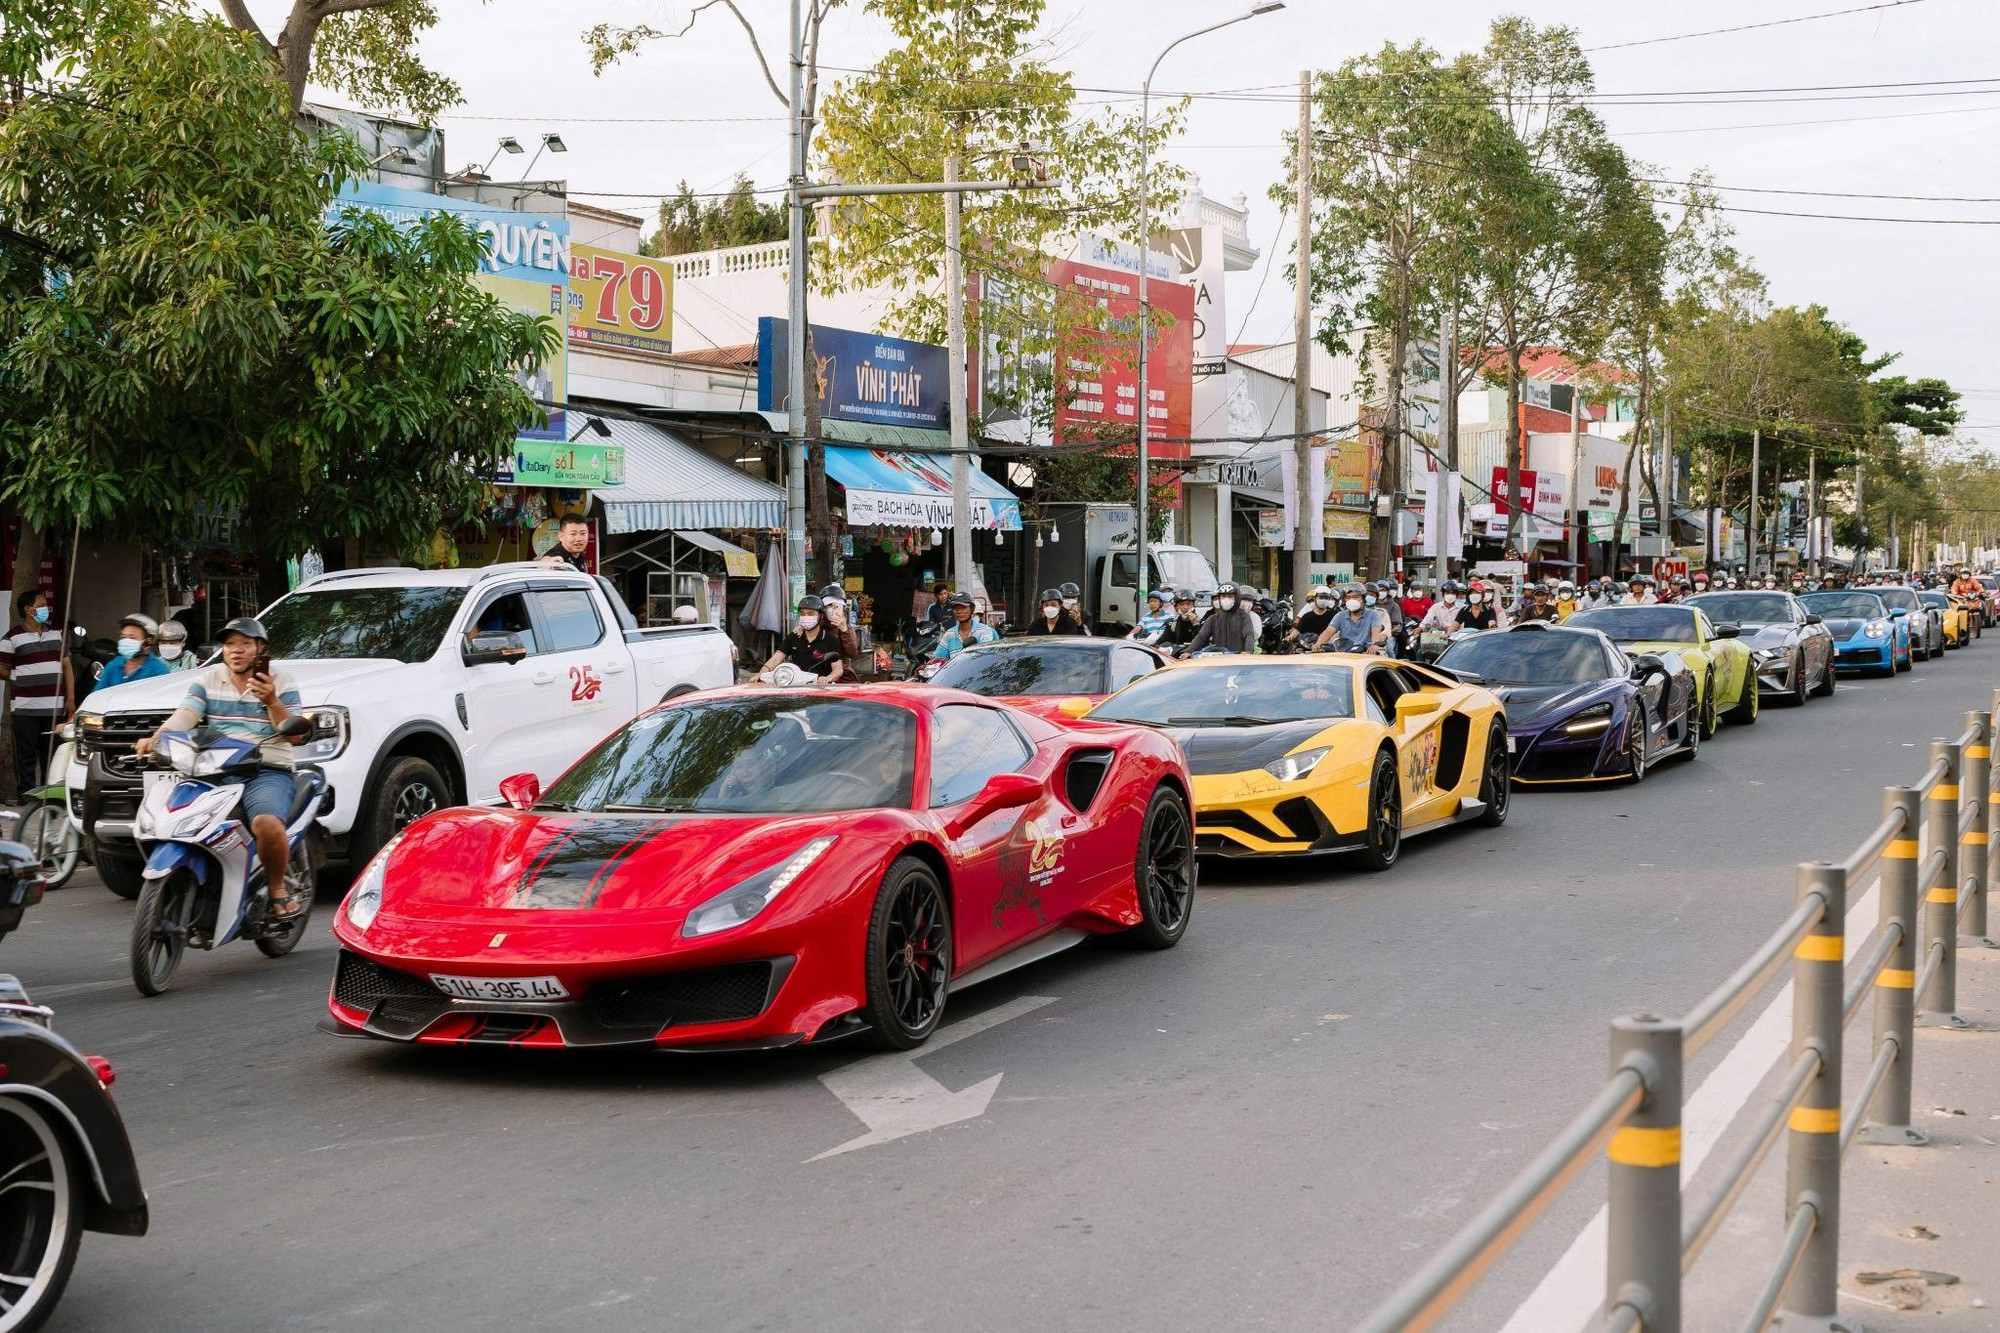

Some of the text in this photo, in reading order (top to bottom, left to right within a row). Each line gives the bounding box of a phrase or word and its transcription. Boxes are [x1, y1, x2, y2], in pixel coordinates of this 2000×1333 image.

[593, 254, 665, 330] 79
[856, 360, 922, 407] VĨNH PHÁT
[877, 497, 902, 514] BÁCH
[905, 499, 923, 516] HÓA
[926, 500, 953, 524] VĨNH
[434, 976, 562, 999] 51H-395.44
